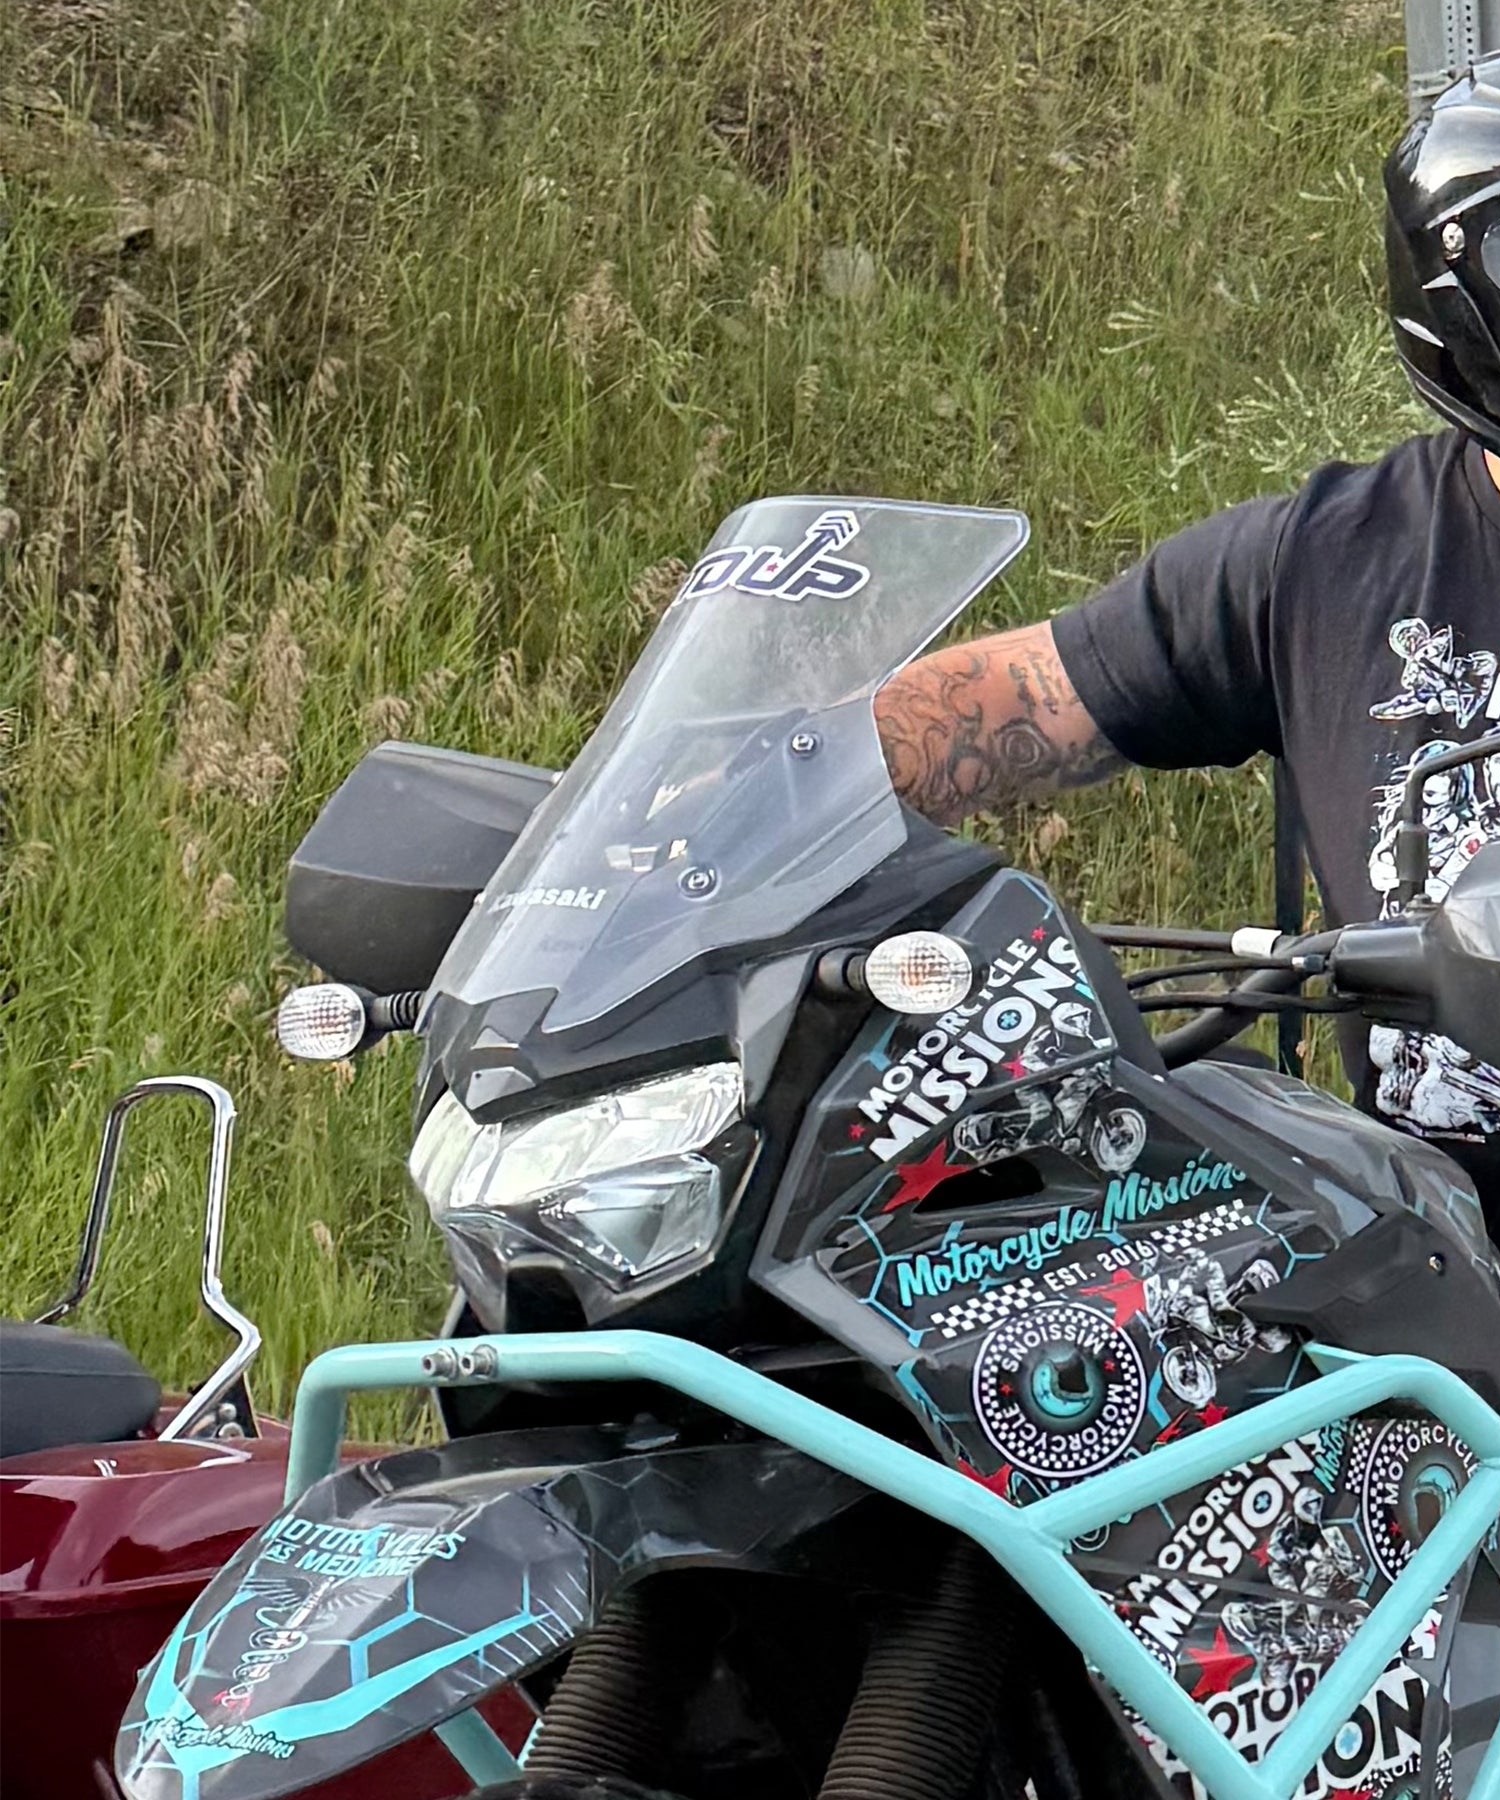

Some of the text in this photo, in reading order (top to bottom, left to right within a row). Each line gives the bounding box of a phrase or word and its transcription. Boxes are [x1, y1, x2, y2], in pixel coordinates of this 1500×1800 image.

[897, 1205, 1098, 1307] Motorcycle
[1044, 1241, 1156, 1293] EST. 2016
[1001, 1323, 1105, 1374] MISSIONS
[1002, 1382, 1124, 1452] MOTORCYCLE
